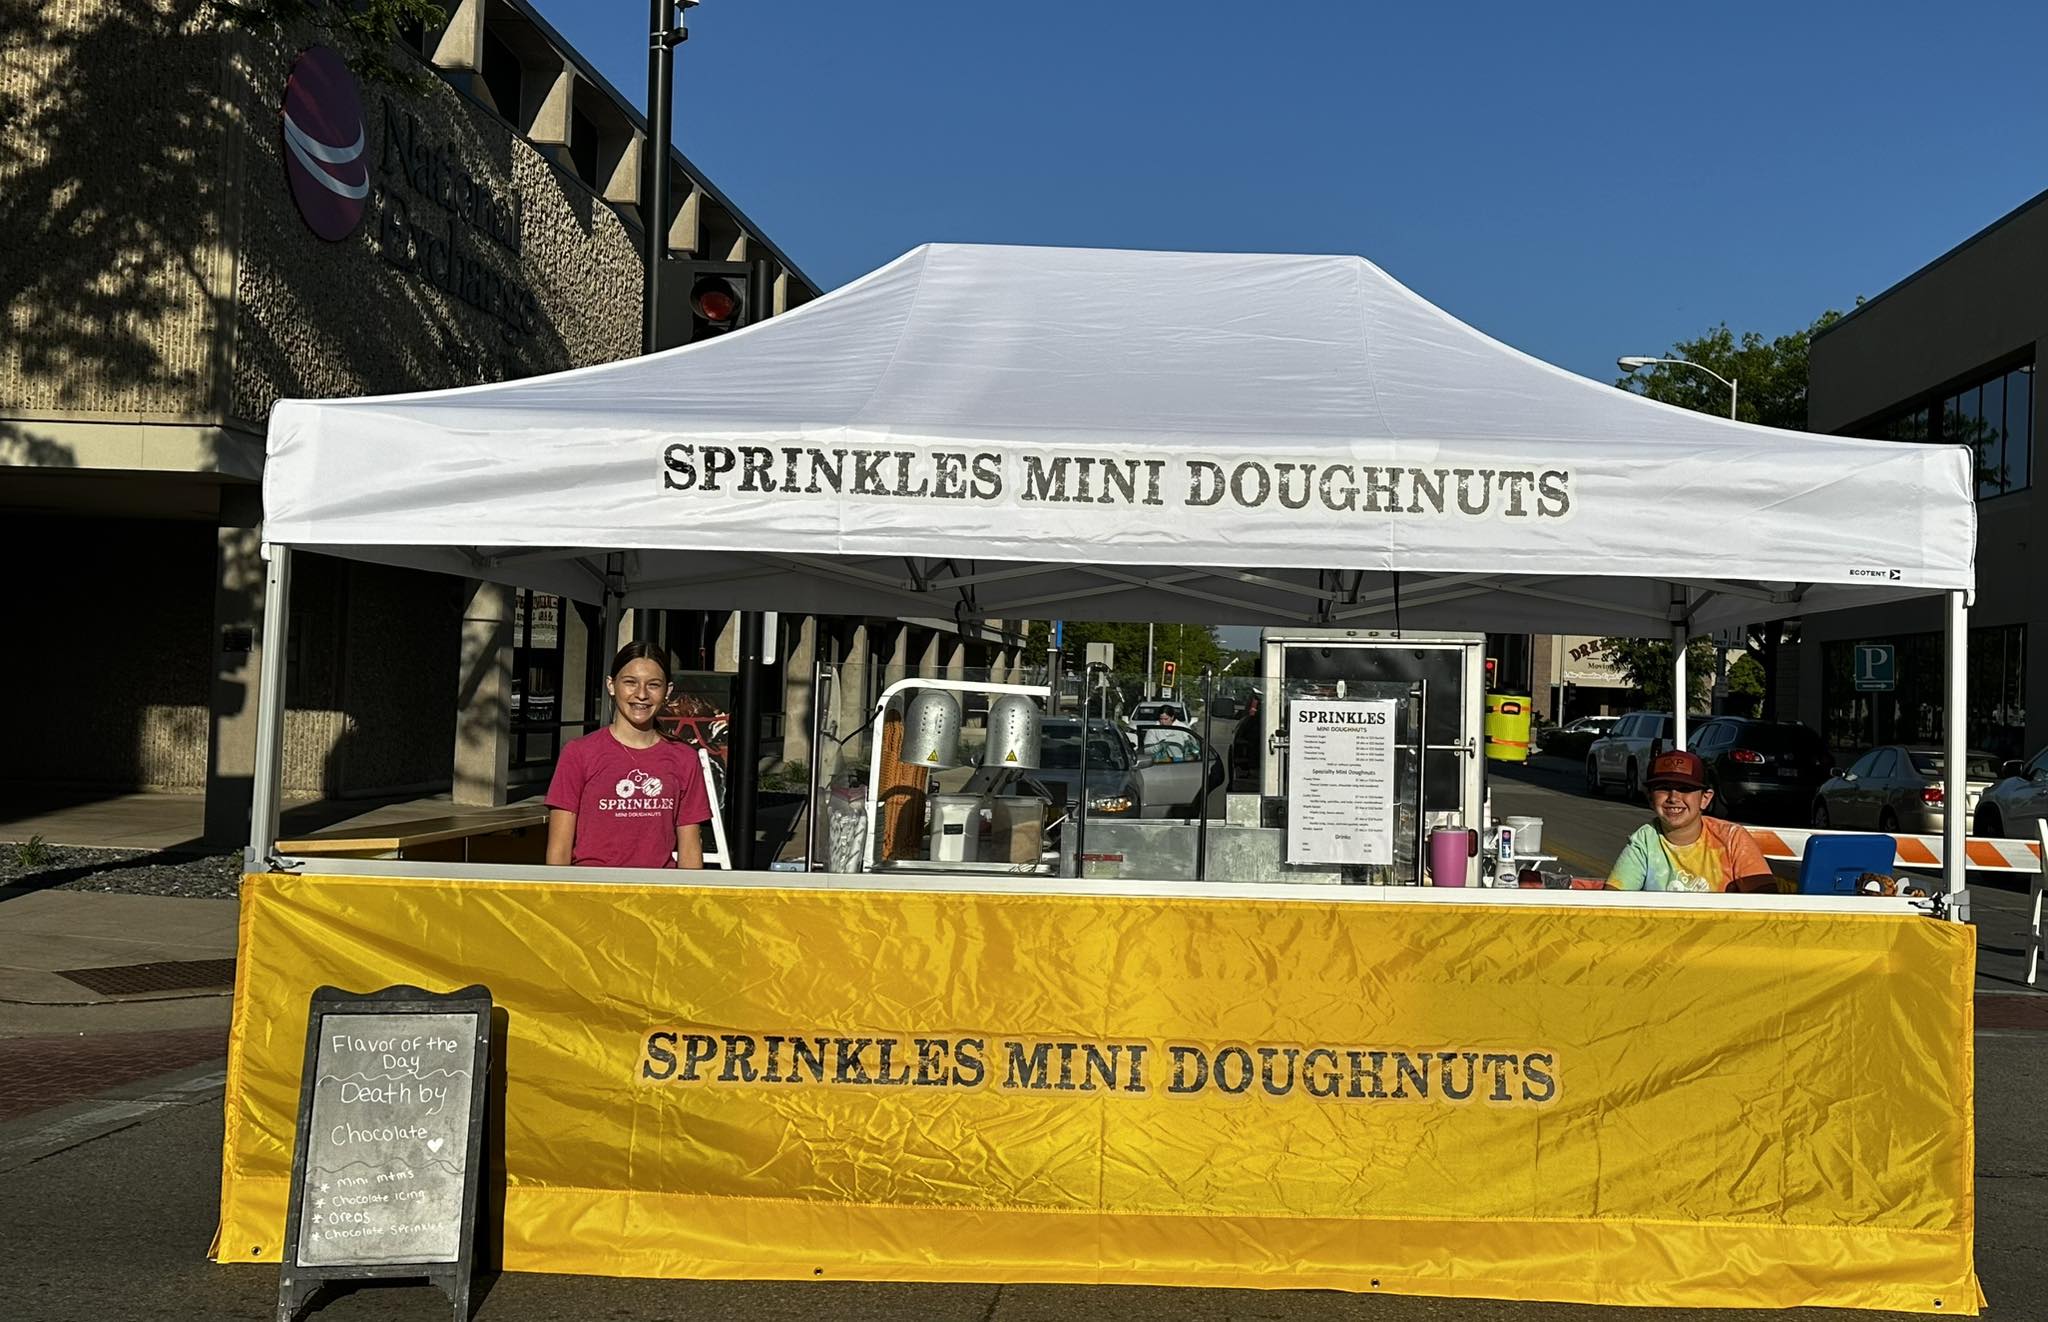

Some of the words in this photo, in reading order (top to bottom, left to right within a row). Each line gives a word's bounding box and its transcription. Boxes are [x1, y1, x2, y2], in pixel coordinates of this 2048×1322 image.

[378, 96, 521, 258] National
[380, 185, 536, 344] Exchange
[663, 443, 1003, 500] SPRINKLES
[1021, 455, 1165, 505] MINI
[1184, 460, 1570, 518] DOUGHNUTS
[1849, 569, 1887, 577] ECOTENT
[1861, 647, 1888, 679] P
[1299, 710, 1386, 725] SPRINKLES
[599, 798, 674, 811] SPRINKLES
[332, 1035, 397, 1053] Flavor
[426, 1036, 458, 1053] the
[382, 1054, 420, 1074] Day
[642, 1031, 985, 1088] SPRINKLES
[1002, 1041, 1148, 1093] MINI
[1168, 1045, 1556, 1102] DOUGHNUTS
[341, 1082, 411, 1105] Death
[419, 1083, 448, 1116] by
[331, 1122, 428, 1146] Chocolate
